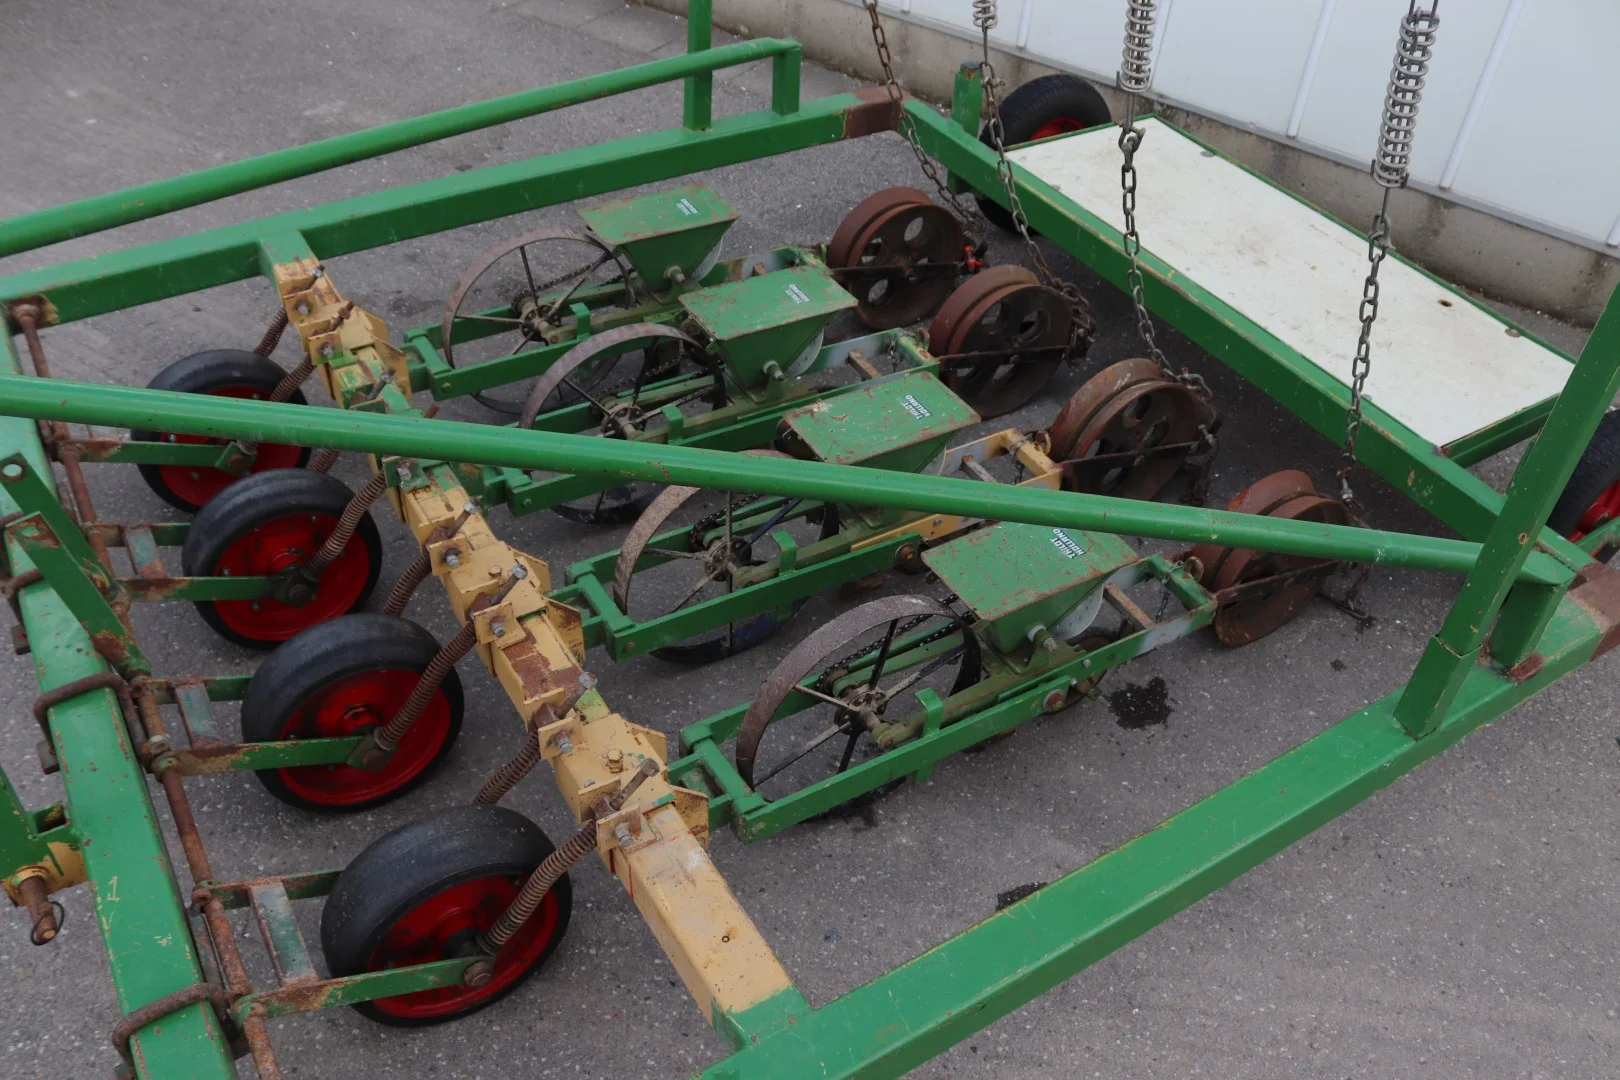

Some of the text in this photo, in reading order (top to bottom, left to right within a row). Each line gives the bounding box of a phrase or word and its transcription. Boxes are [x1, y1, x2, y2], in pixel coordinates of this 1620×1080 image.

[902, 402, 923, 419] THILOT
[905, 394, 931, 416] HOLLAND
[1050, 537, 1076, 559] THILOT
[1053, 528, 1085, 555] HOLLAND
